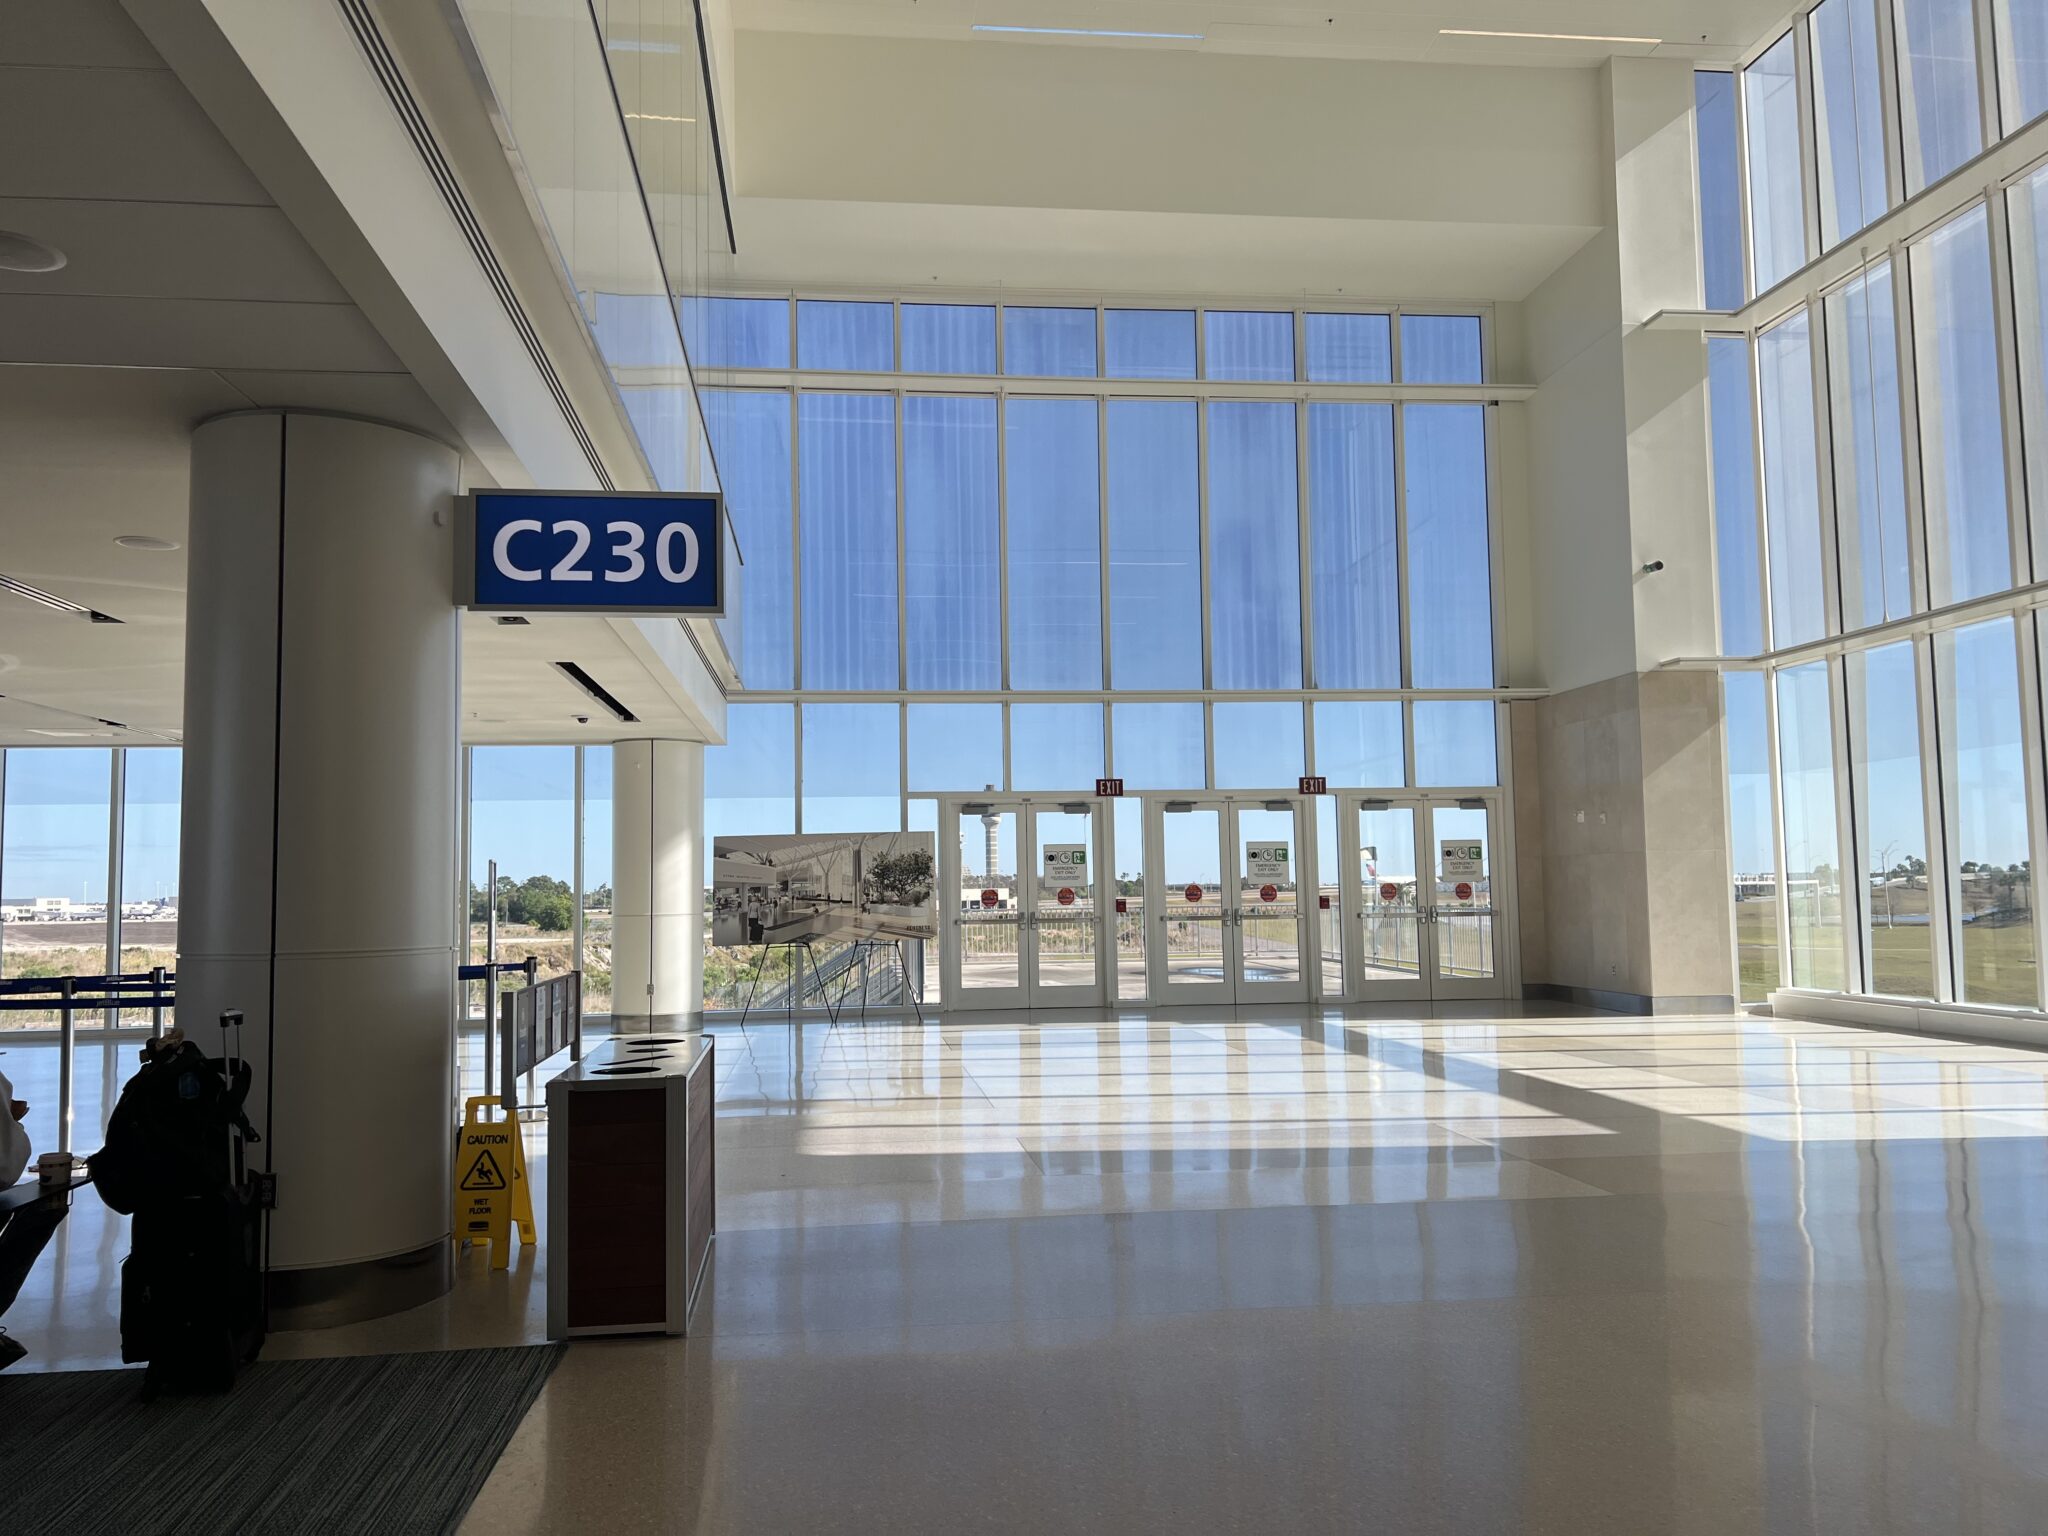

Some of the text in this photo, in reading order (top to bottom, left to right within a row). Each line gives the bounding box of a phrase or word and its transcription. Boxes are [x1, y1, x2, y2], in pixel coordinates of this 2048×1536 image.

[493, 519, 699, 583] C230
[1100, 780, 1121, 795] EXIT
[1303, 778, 1324, 793] EXIT
[467, 1135, 509, 1145] CAUTION
